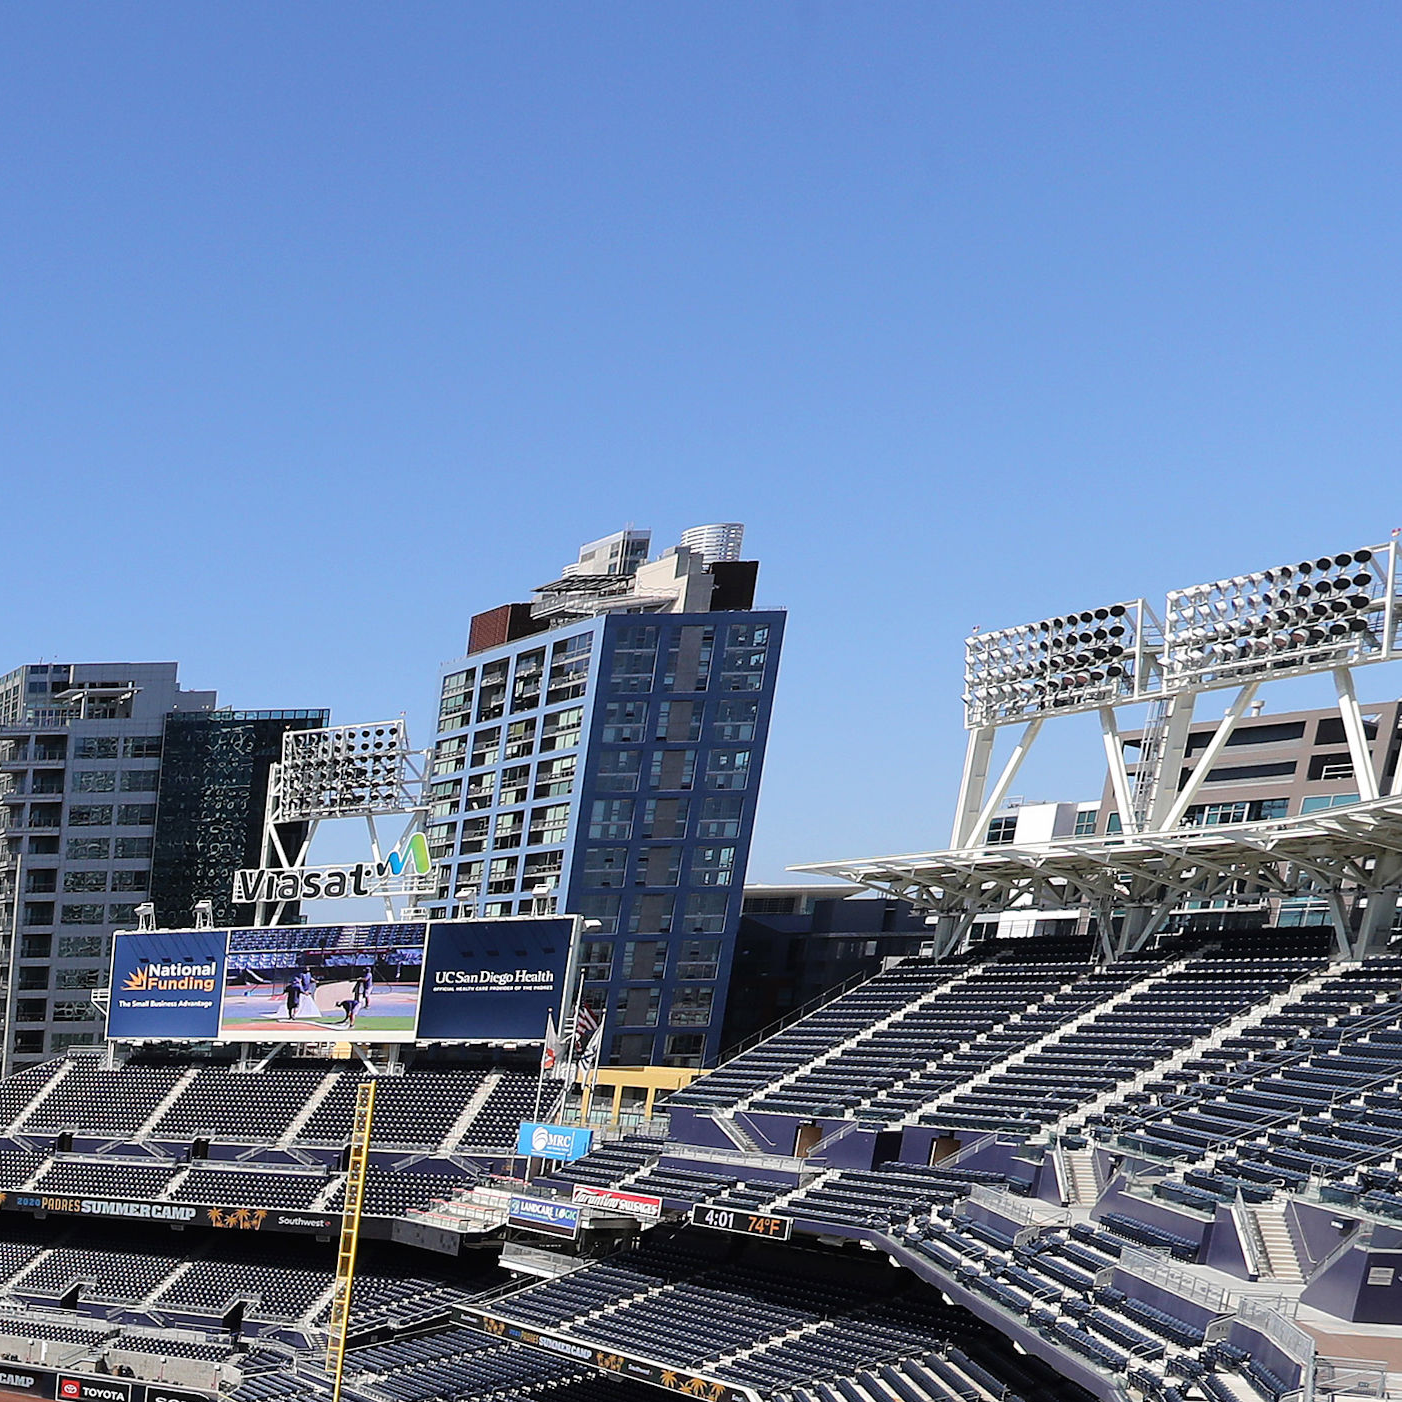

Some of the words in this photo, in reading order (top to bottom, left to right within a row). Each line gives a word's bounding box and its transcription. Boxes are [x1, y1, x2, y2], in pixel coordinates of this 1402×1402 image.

[240, 864, 369, 901] Viasat
[148, 962, 217, 977] National
[148, 977, 215, 992] Funding
[479, 970, 514, 985] Diego
[514, 970, 553, 983] Health
[178, 1000, 213, 1008] Advantage
[547, 1134, 572, 1148] MRC
[16, 1197, 41, 1207] 2020
[41, 1196, 81, 1213] PADRES
[80, 1200, 151, 1217] SUMMER
[151, 1205, 196, 1220] CAMP
[520, 1201, 554, 1217] LANDCARE
[278, 1216, 325, 1228] Southwest
[705, 1209, 734, 1229] 4:01
[748, 1216, 781, 1236] 74°F
[570, 1344, 592, 1360] CAMP
[82, 1387, 125, 1402] TOYOTA
